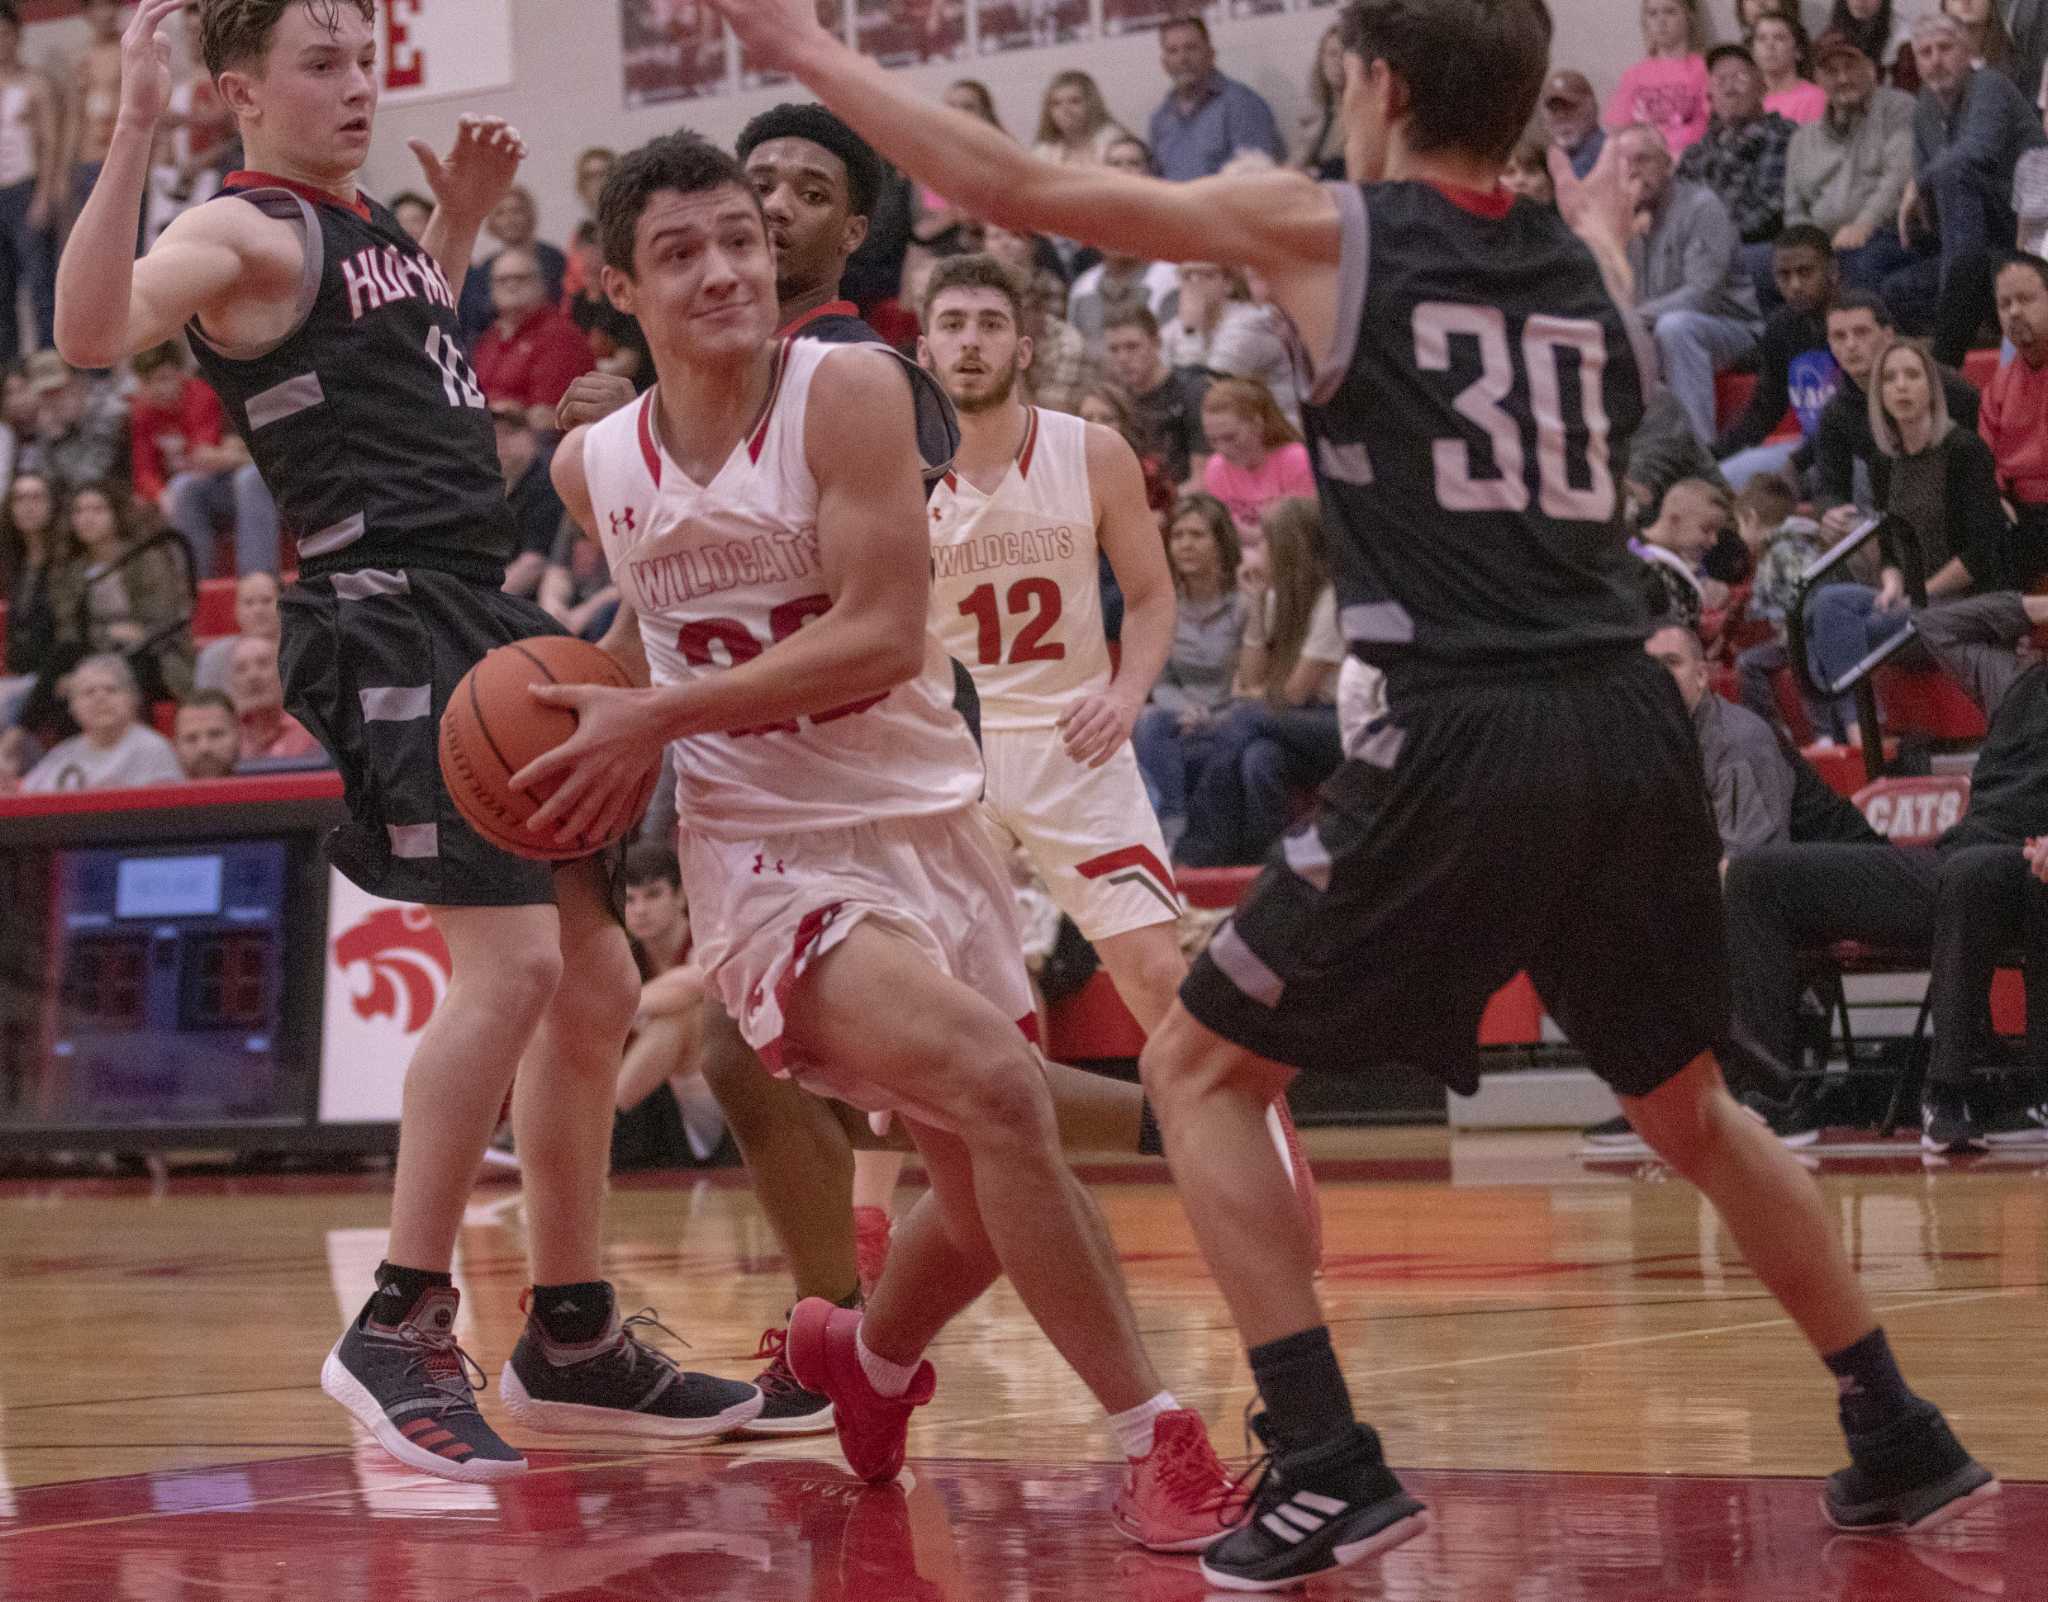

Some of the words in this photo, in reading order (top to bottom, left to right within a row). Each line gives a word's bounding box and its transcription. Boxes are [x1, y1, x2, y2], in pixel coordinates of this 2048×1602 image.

[1411, 302, 1616, 522] 30
[931, 526, 1074, 578] WILDCATS
[957, 576, 1066, 665] 12
[1865, 790, 1961, 837] CATS
